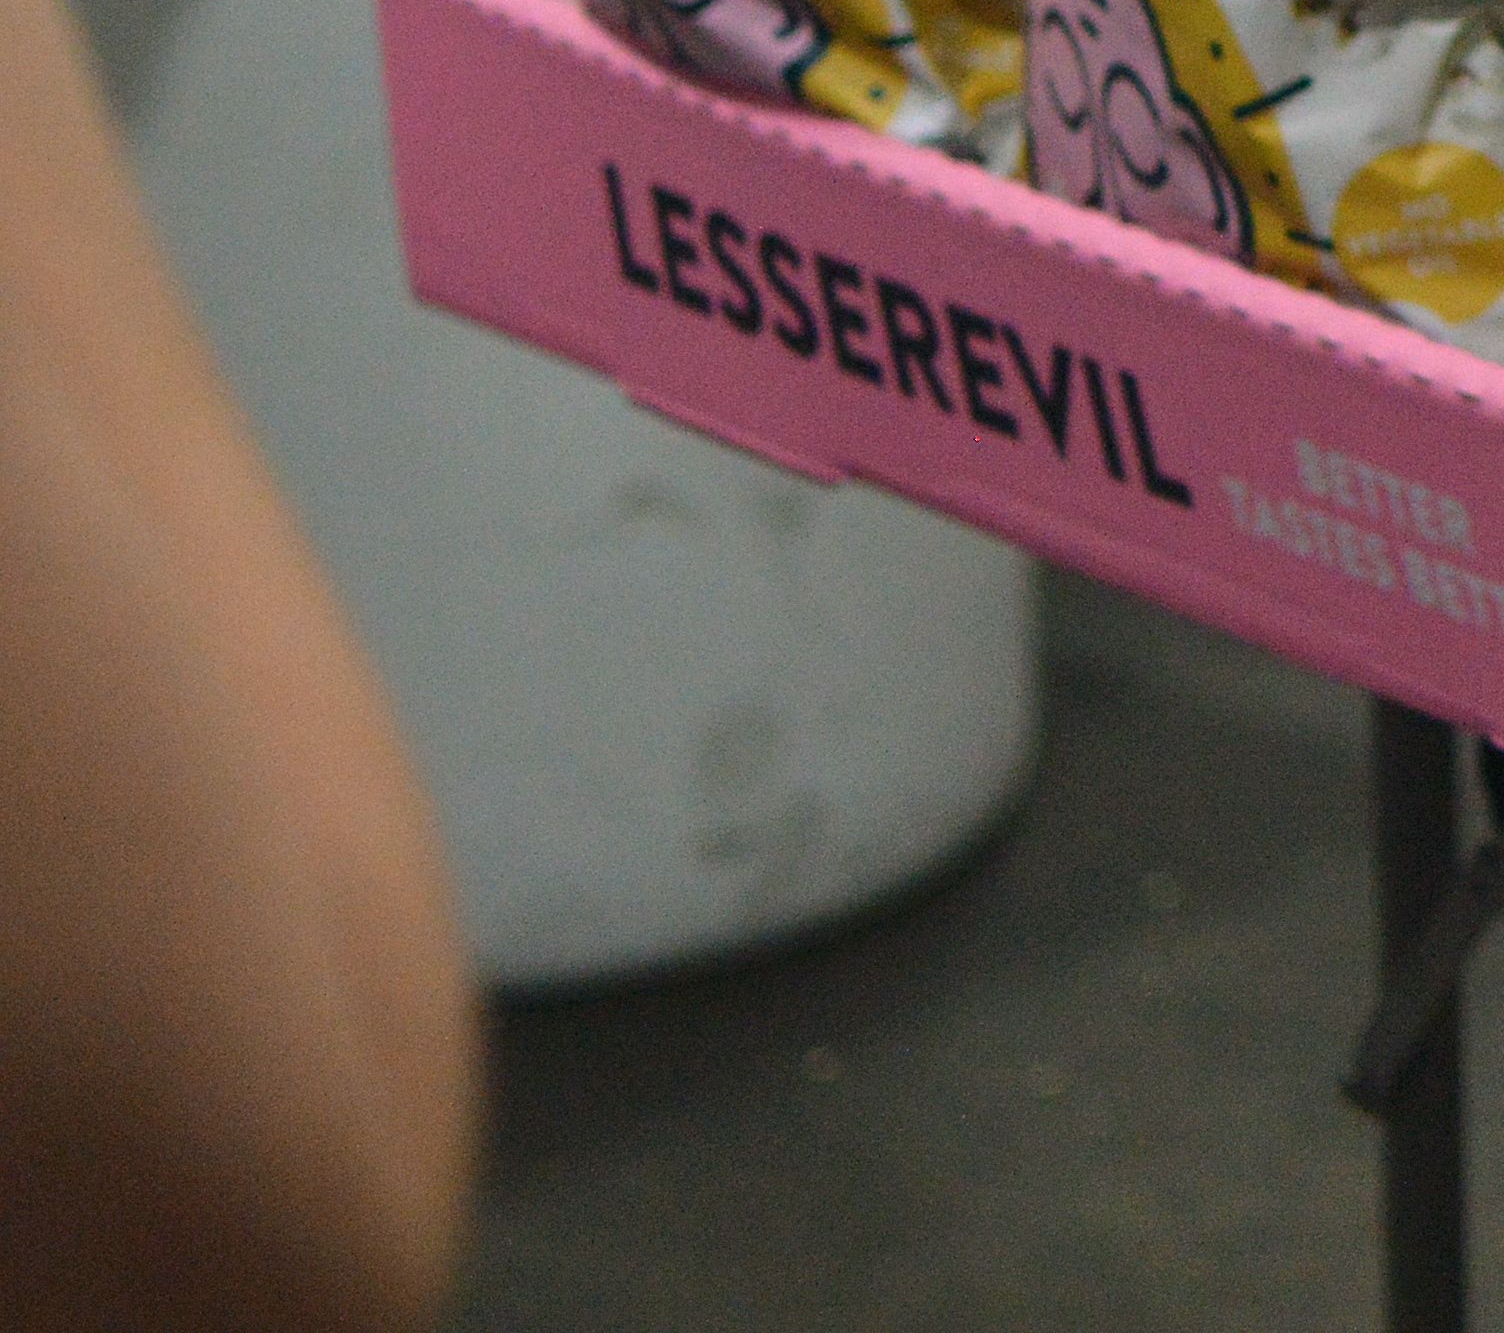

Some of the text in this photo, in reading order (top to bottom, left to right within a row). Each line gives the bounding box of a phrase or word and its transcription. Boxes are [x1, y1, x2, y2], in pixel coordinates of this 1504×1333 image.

[602, 163, 1195, 508] LESSEREVIL
[1221, 475, 1398, 593] TASTES
[1293, 438, 1476, 555] BETTER
